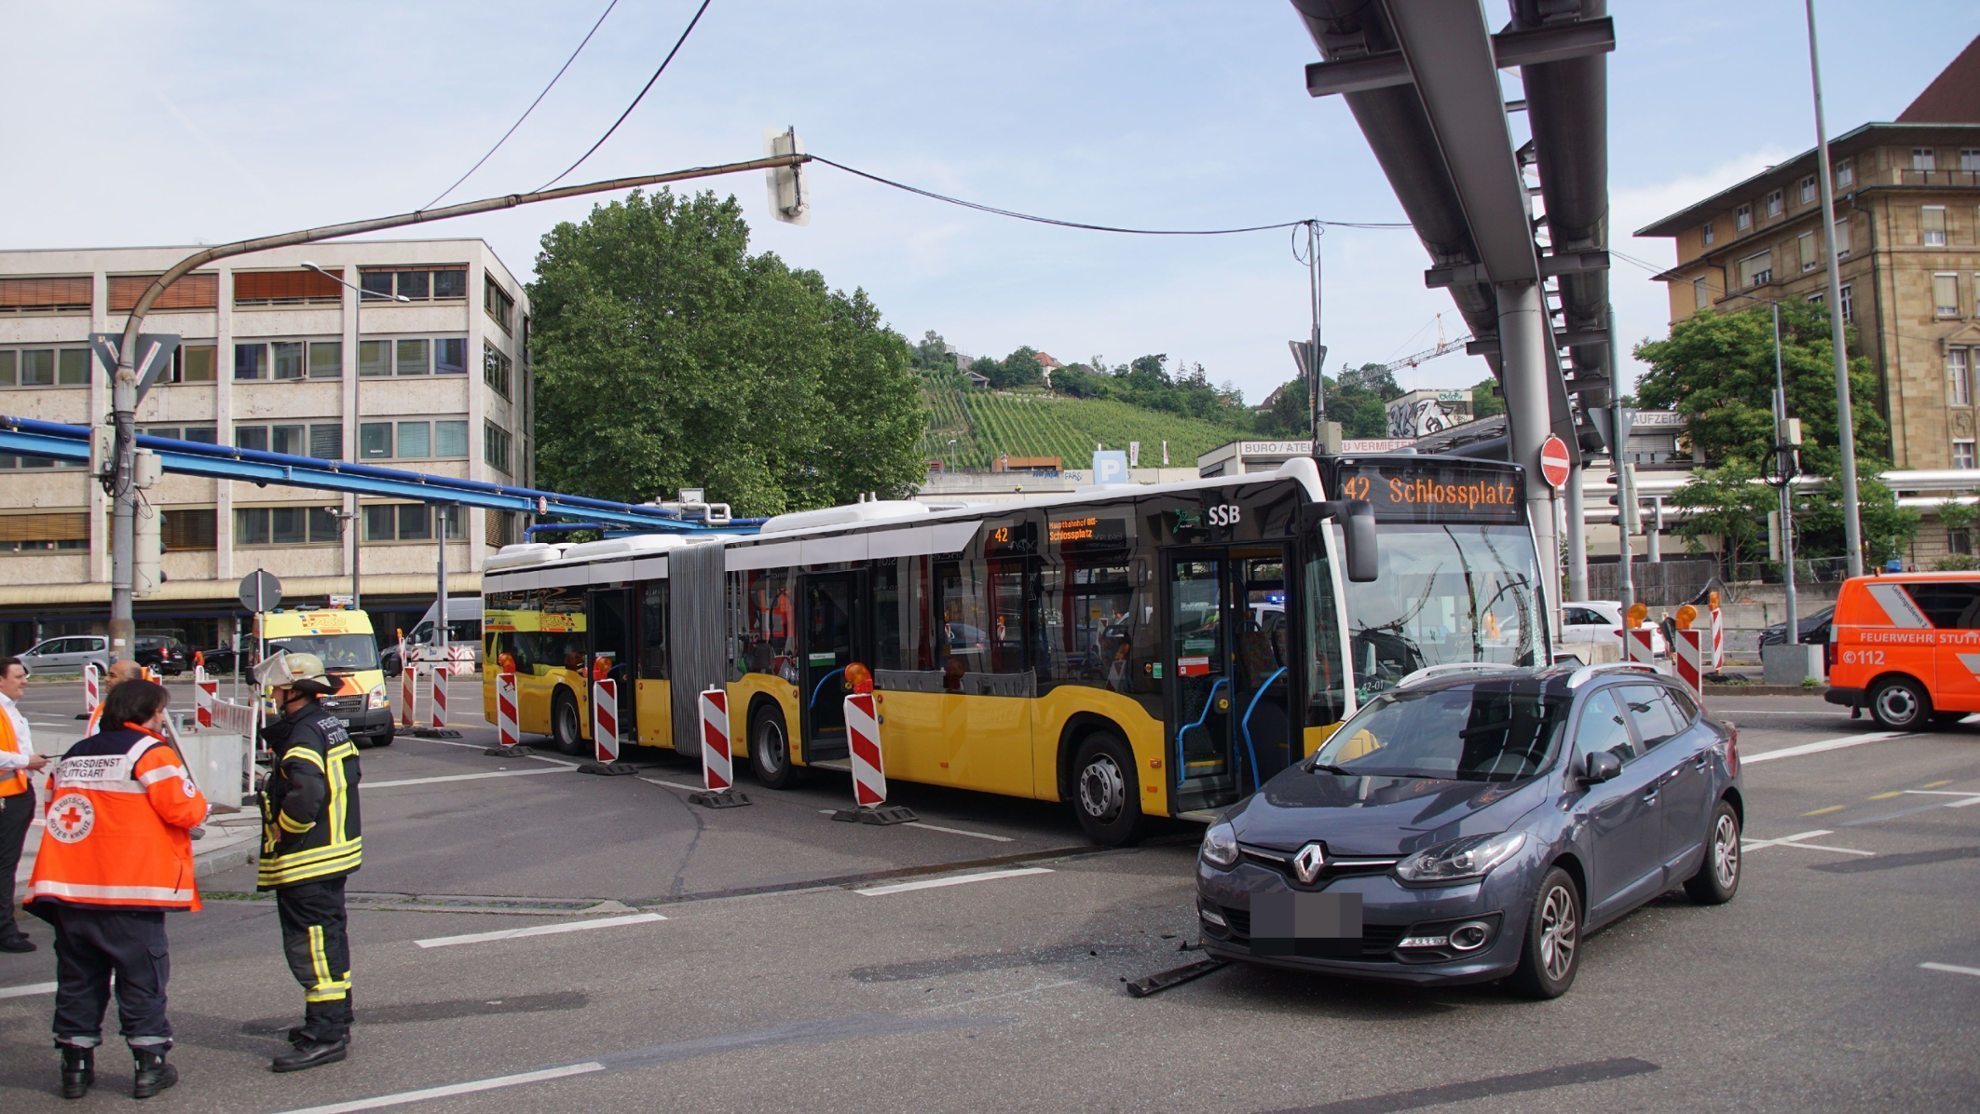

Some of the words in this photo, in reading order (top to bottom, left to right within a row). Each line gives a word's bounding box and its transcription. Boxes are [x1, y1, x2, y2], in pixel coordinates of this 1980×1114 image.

[1286, 442, 1313, 453] ATEL
[1100, 459, 1120, 481] P
[1343, 476, 1370, 501] 42
[1389, 476, 1515, 510] Schlossplatz
[1209, 504, 1240, 526] SSB
[995, 527, 1008, 542] 42
[1049, 529, 1093, 541] Schlossplatz
[1860, 632, 1934, 643] FEUERWEHR
[1940, 632, 1980, 644] STUTT
[1857, 650, 1885, 665] 112
